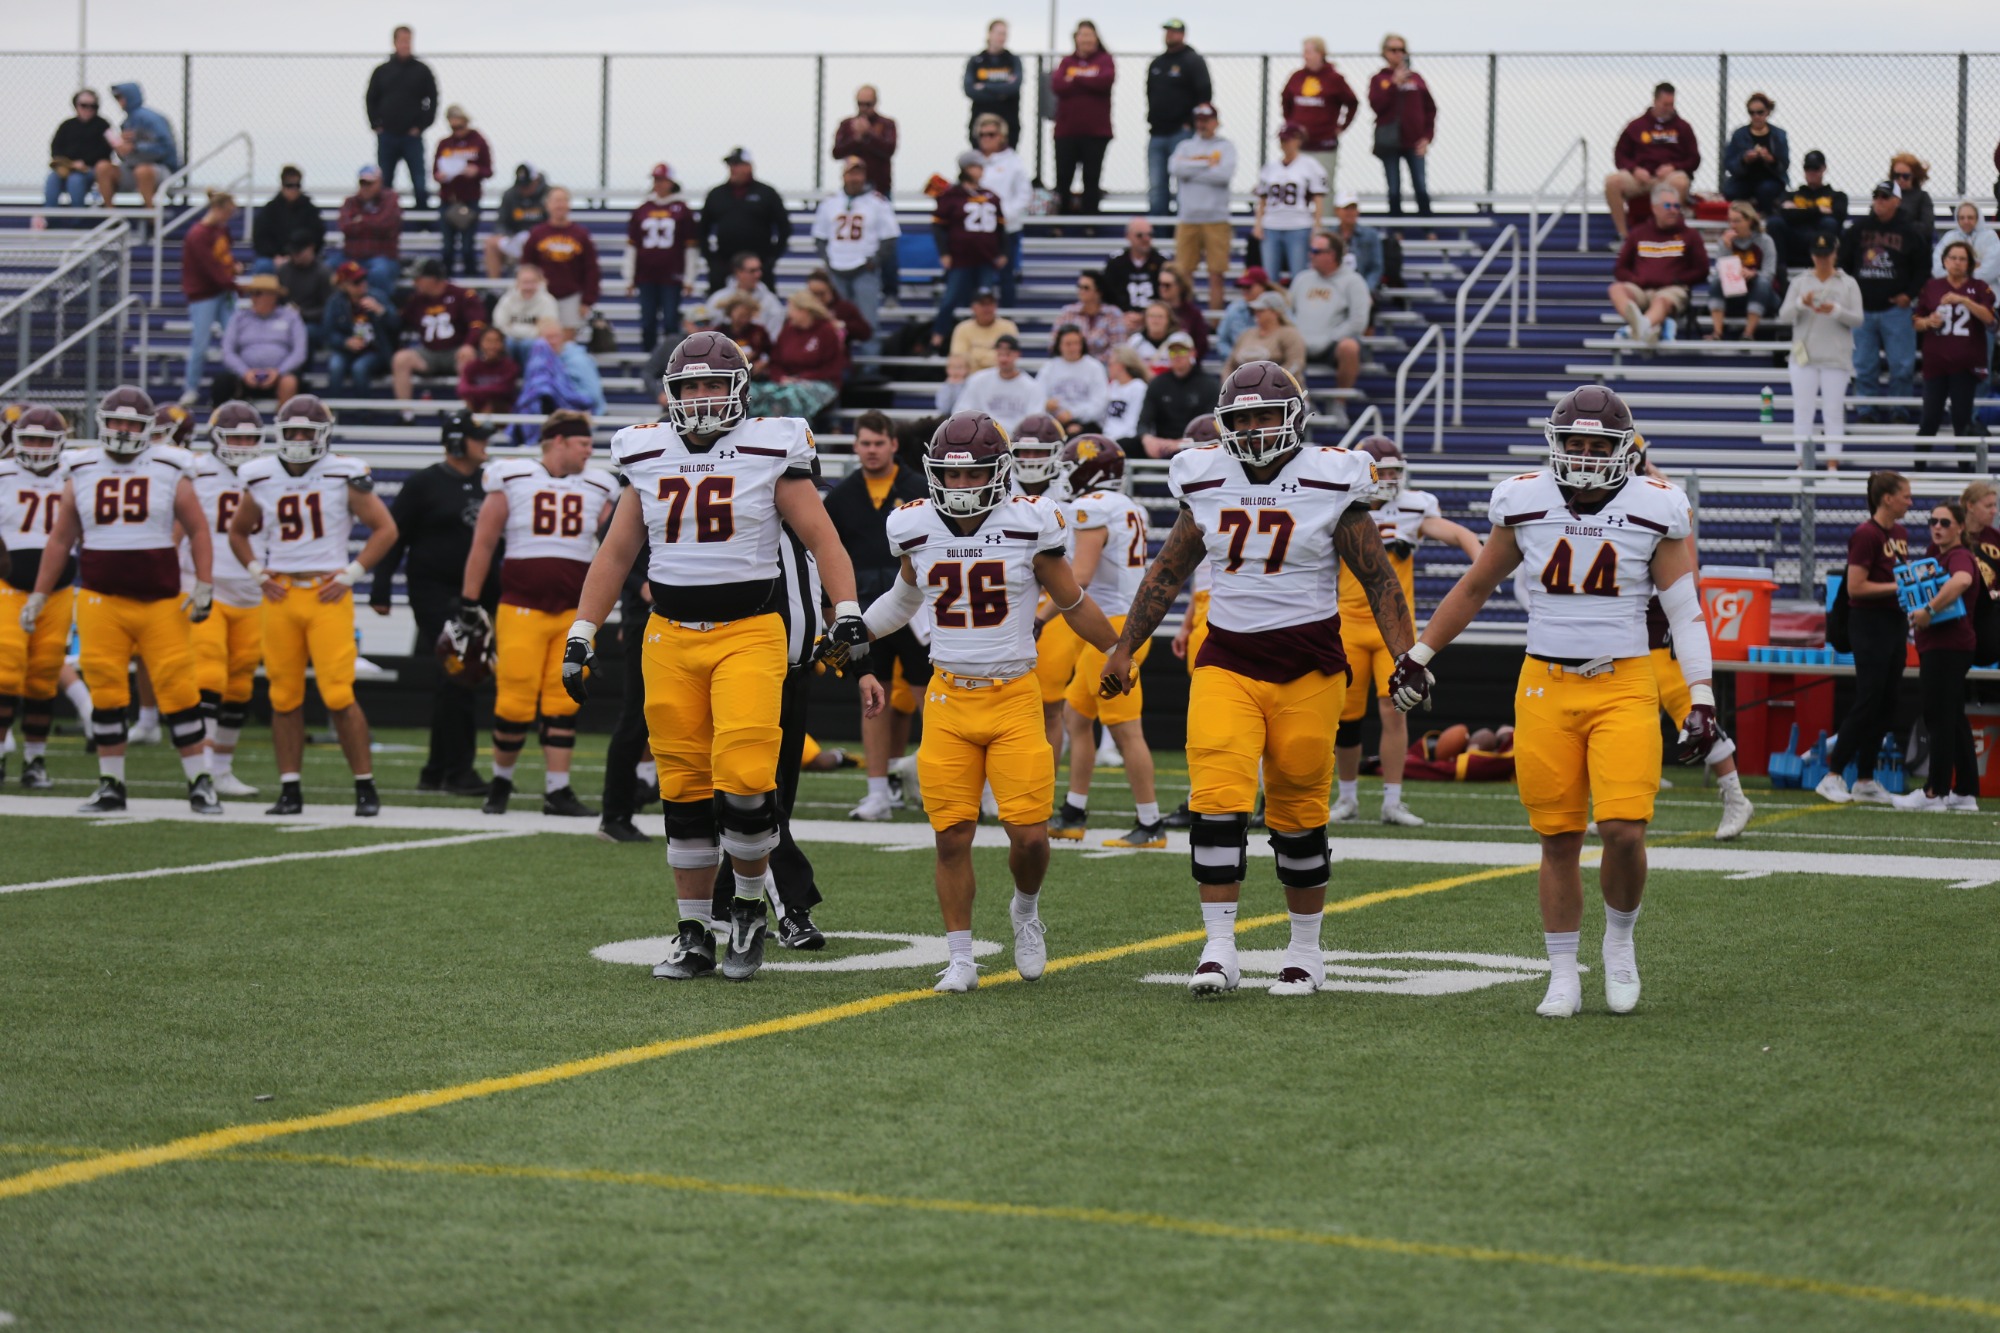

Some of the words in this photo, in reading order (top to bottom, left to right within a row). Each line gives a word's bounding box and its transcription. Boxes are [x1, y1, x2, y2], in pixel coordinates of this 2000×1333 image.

[835, 215, 864, 241] 26
[963, 202, 997, 232] 26
[641, 217, 675, 249] 33
[1575, 420, 1600, 428] Riddell
[679, 463, 715, 474] BULLDOGS
[94, 477, 149, 526] 69
[277, 491, 324, 542] 91
[533, 491, 583, 538] 68
[657, 476, 736, 544] 76
[1240, 496, 1277, 506] BULLDOGS
[1217, 508, 1296, 575] 77
[1565, 525, 1604, 538] BULLDOGS
[946, 548, 983, 559] BULLDOGS
[1540, 537, 1620, 597] 44
[927, 559, 1010, 630] 26
[1714, 591, 1739, 619] G
